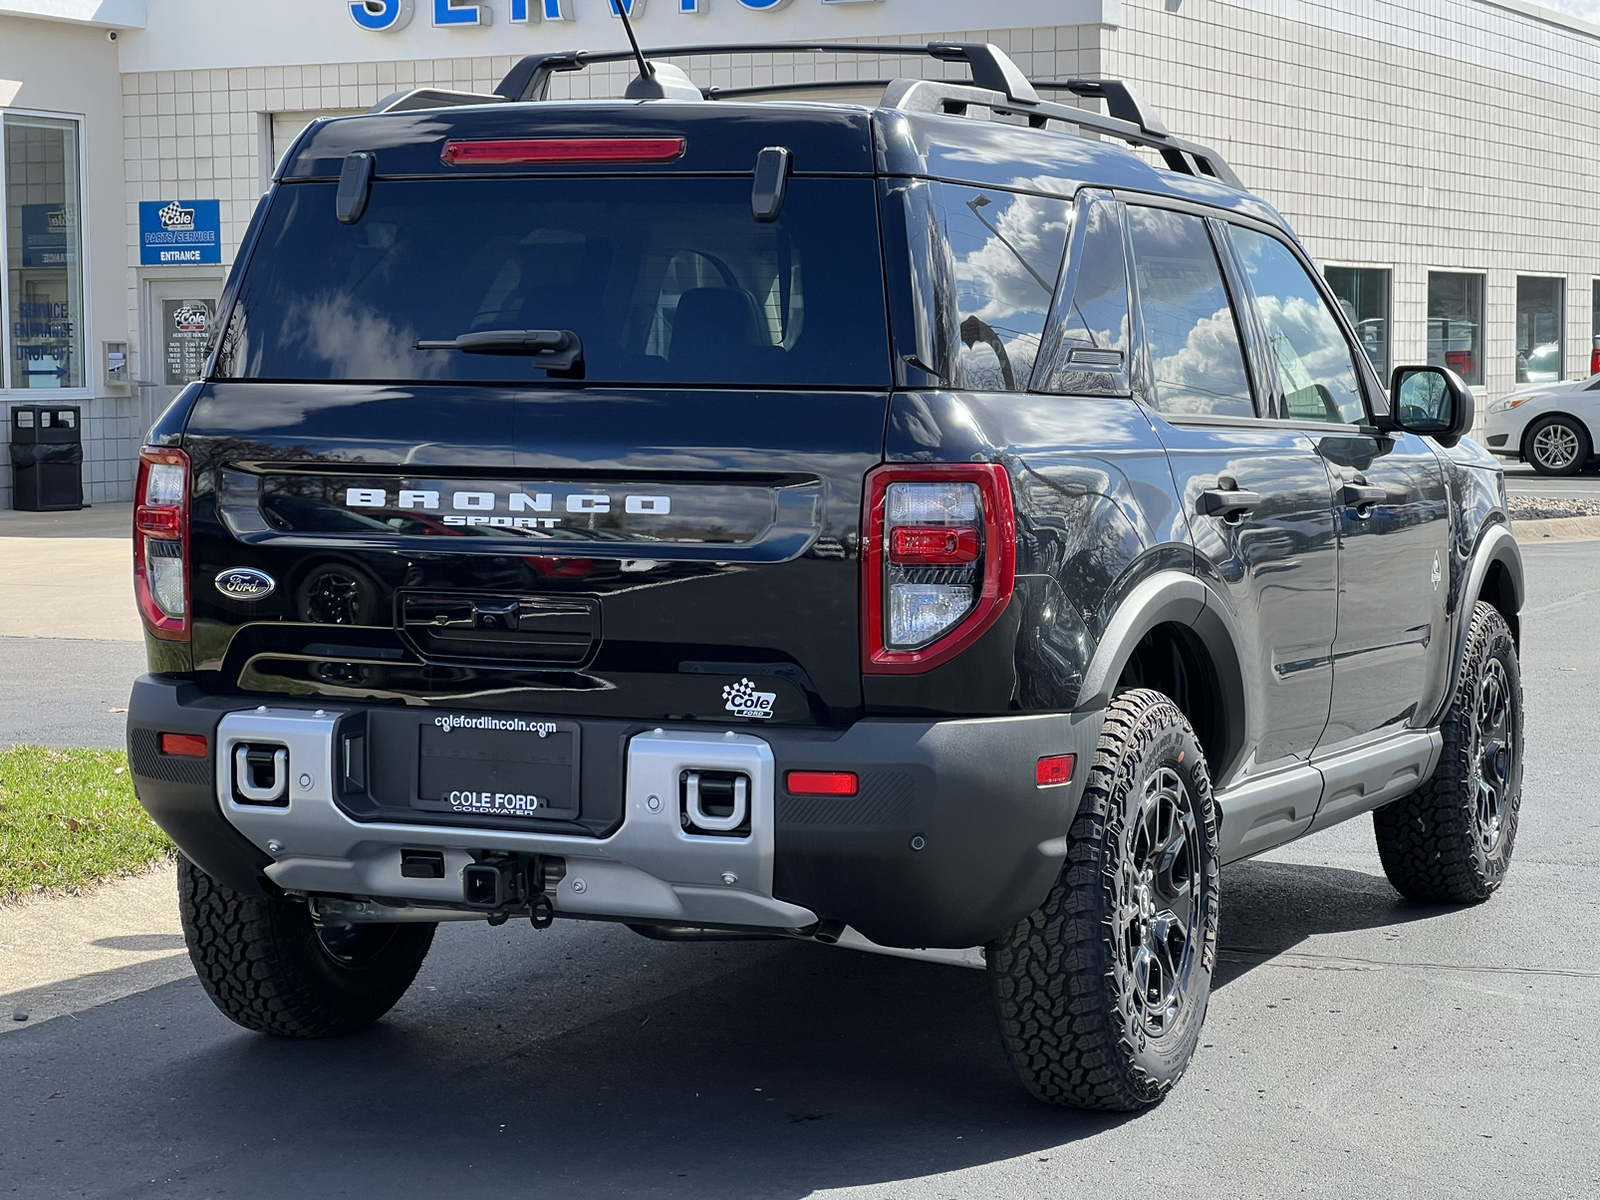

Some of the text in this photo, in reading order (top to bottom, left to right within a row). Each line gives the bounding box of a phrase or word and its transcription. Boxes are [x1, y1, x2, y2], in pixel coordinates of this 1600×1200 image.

[165, 212, 191, 224] Cole
[145, 231, 215, 243] PARTS/SERVICE
[160, 250, 201, 261] ENTRANCE
[181, 312, 205, 325] Cole
[346, 488, 671, 515] BRONCO
[443, 515, 561, 528] SPORT
[227, 574, 259, 592] Ford
[730, 693, 770, 709] Cole
[434, 714, 557, 733] colefordlincoln.com
[450, 790, 538, 811] COLE FORD
[452, 805, 534, 816] COLDWATER
